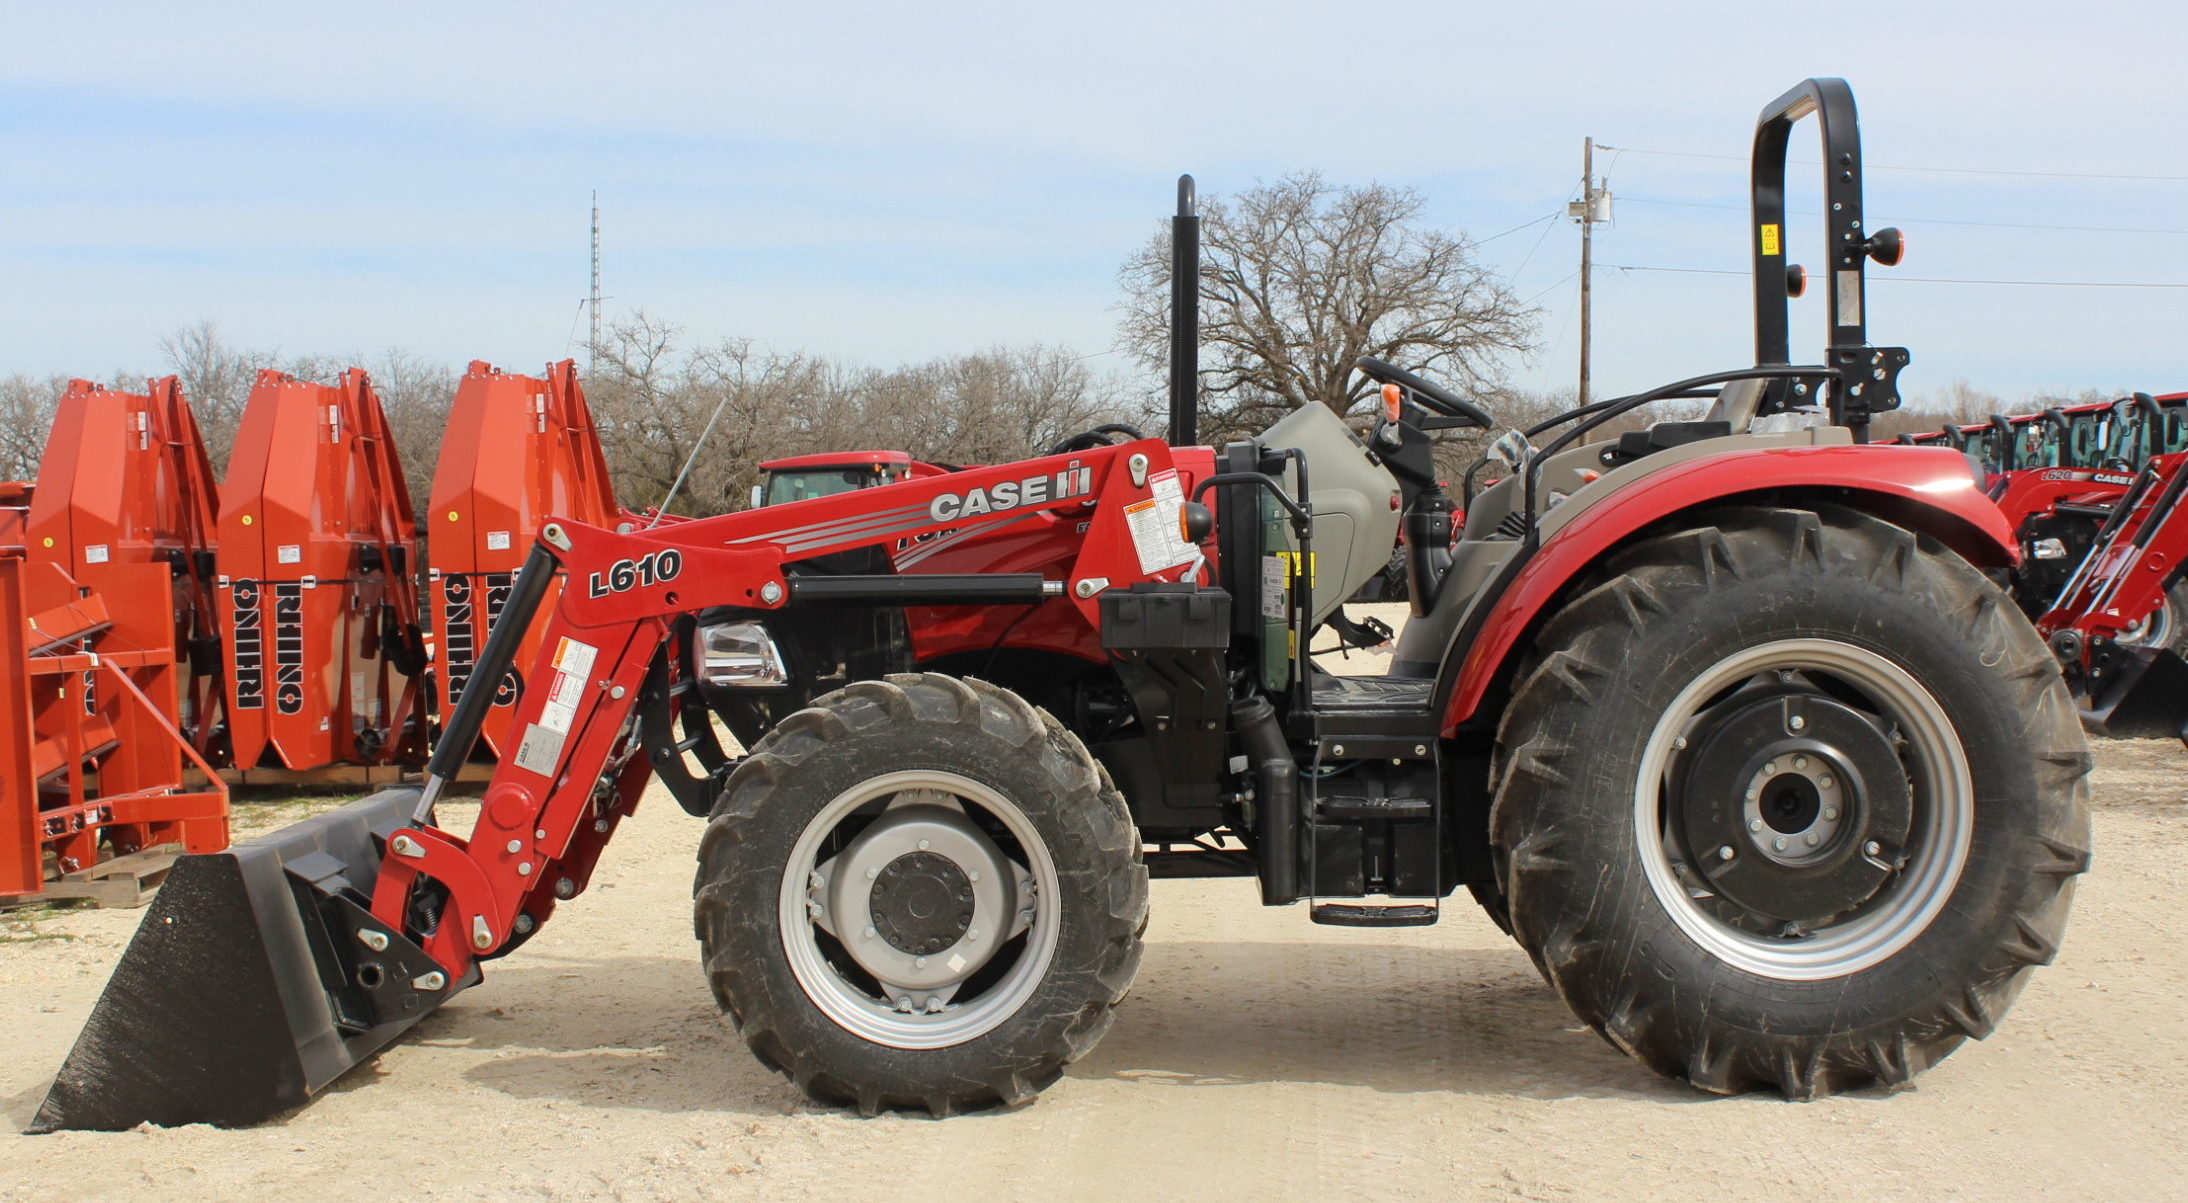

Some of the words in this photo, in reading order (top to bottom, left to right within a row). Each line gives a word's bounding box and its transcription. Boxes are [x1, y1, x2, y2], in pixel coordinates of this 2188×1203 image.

[930, 474, 1049, 522] CASE
[2041, 470, 2073, 481] L620
[2093, 473, 2127, 485] CASE
[589, 549, 683, 599] L610
[233, 578, 264, 709] RHINO
[275, 584, 304, 715] RHINO
[444, 572, 474, 705] RHINO
